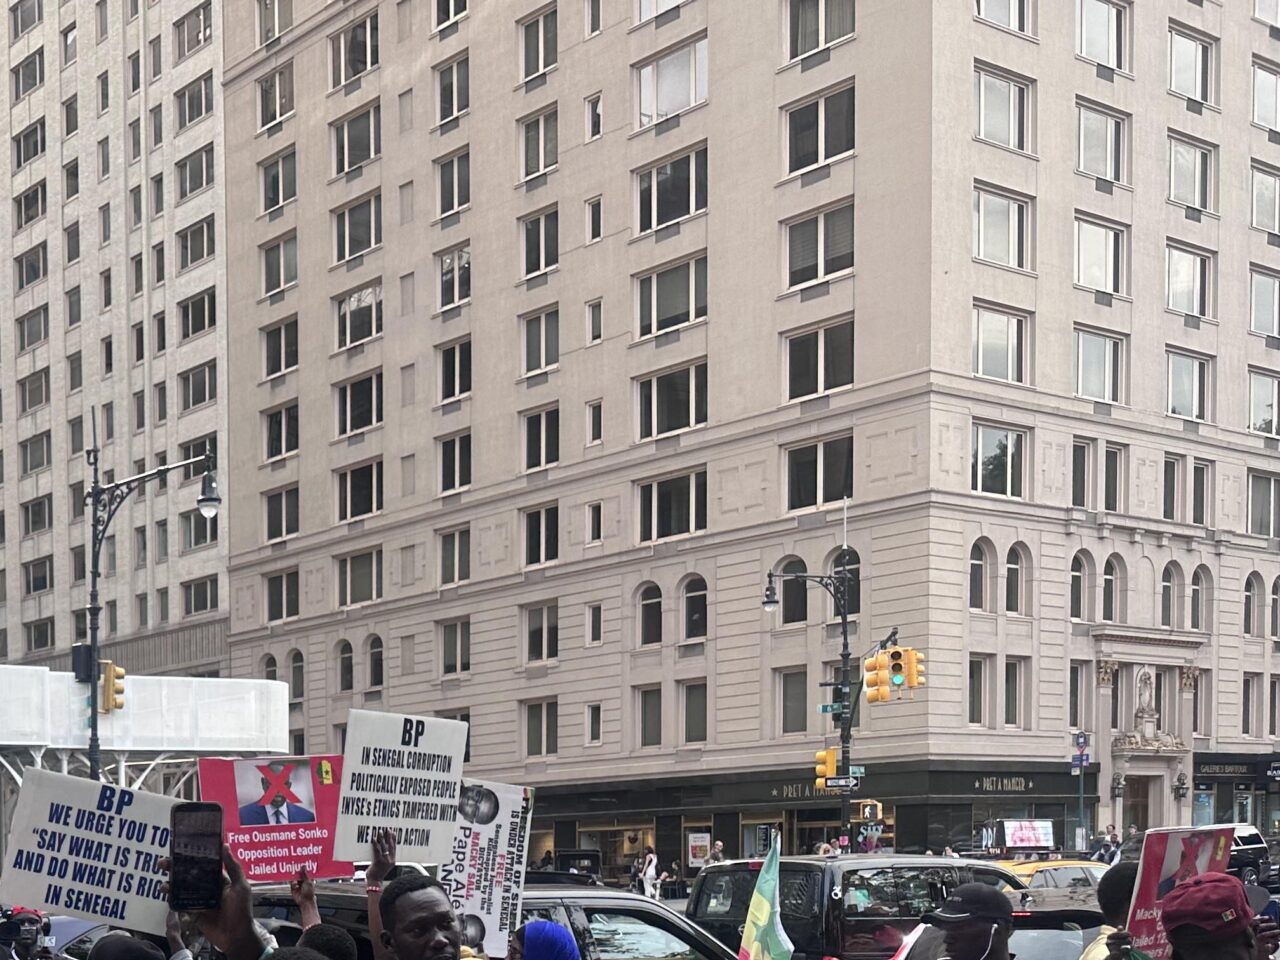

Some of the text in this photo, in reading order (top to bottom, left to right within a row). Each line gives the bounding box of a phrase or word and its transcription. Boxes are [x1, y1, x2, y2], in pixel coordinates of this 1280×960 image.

[401, 718, 425, 748] BP
[361, 746, 453, 773] IN SENEGAL CORRUPTION
[350, 772, 457, 799] POLITICALLY EXPOSED PEOPLE
[783, 784, 802, 798] PRET
[804, 784, 810, 797] A
[983, 776, 1026, 791] PRET A MANGER
[96, 784, 134, 815] BP
[372, 799, 401, 818] ETHICS
[401, 801, 438, 821] TAMPERED
[439, 804, 458, 822] WITH
[48, 802, 72, 827] WE
[74, 808, 115, 836] URGE
[117, 815, 150, 843] YOU
[228, 827, 328, 844] Free Ousmane Sonko
[357, 825, 369, 844] WE
[403, 828, 431, 847] ACTION
[68, 835, 113, 866] WHAT
[113, 846, 130, 868] IS
[133, 850, 169, 877] TRU
[237, 844, 322, 861] Opposition Leader
[465, 831, 481, 901] MACKY SALL
[483, 838, 494, 882] Kidnapped
[13, 849, 45, 874] AND
[47, 856, 69, 880] DO
[71, 861, 116, 890] WHAT
[117, 872, 134, 894] IS
[249, 863, 277, 875] Jailed
[451, 826, 472, 910] Pape Alé
[475, 847, 485, 891] DICTATOR
[494, 854, 506, 888] FREE
[499, 810, 520, 932] IS UNDER ATTACK IN SENEGAL
[512, 869, 522, 889] OF
[44, 884, 127, 920] IN SENEGAL
